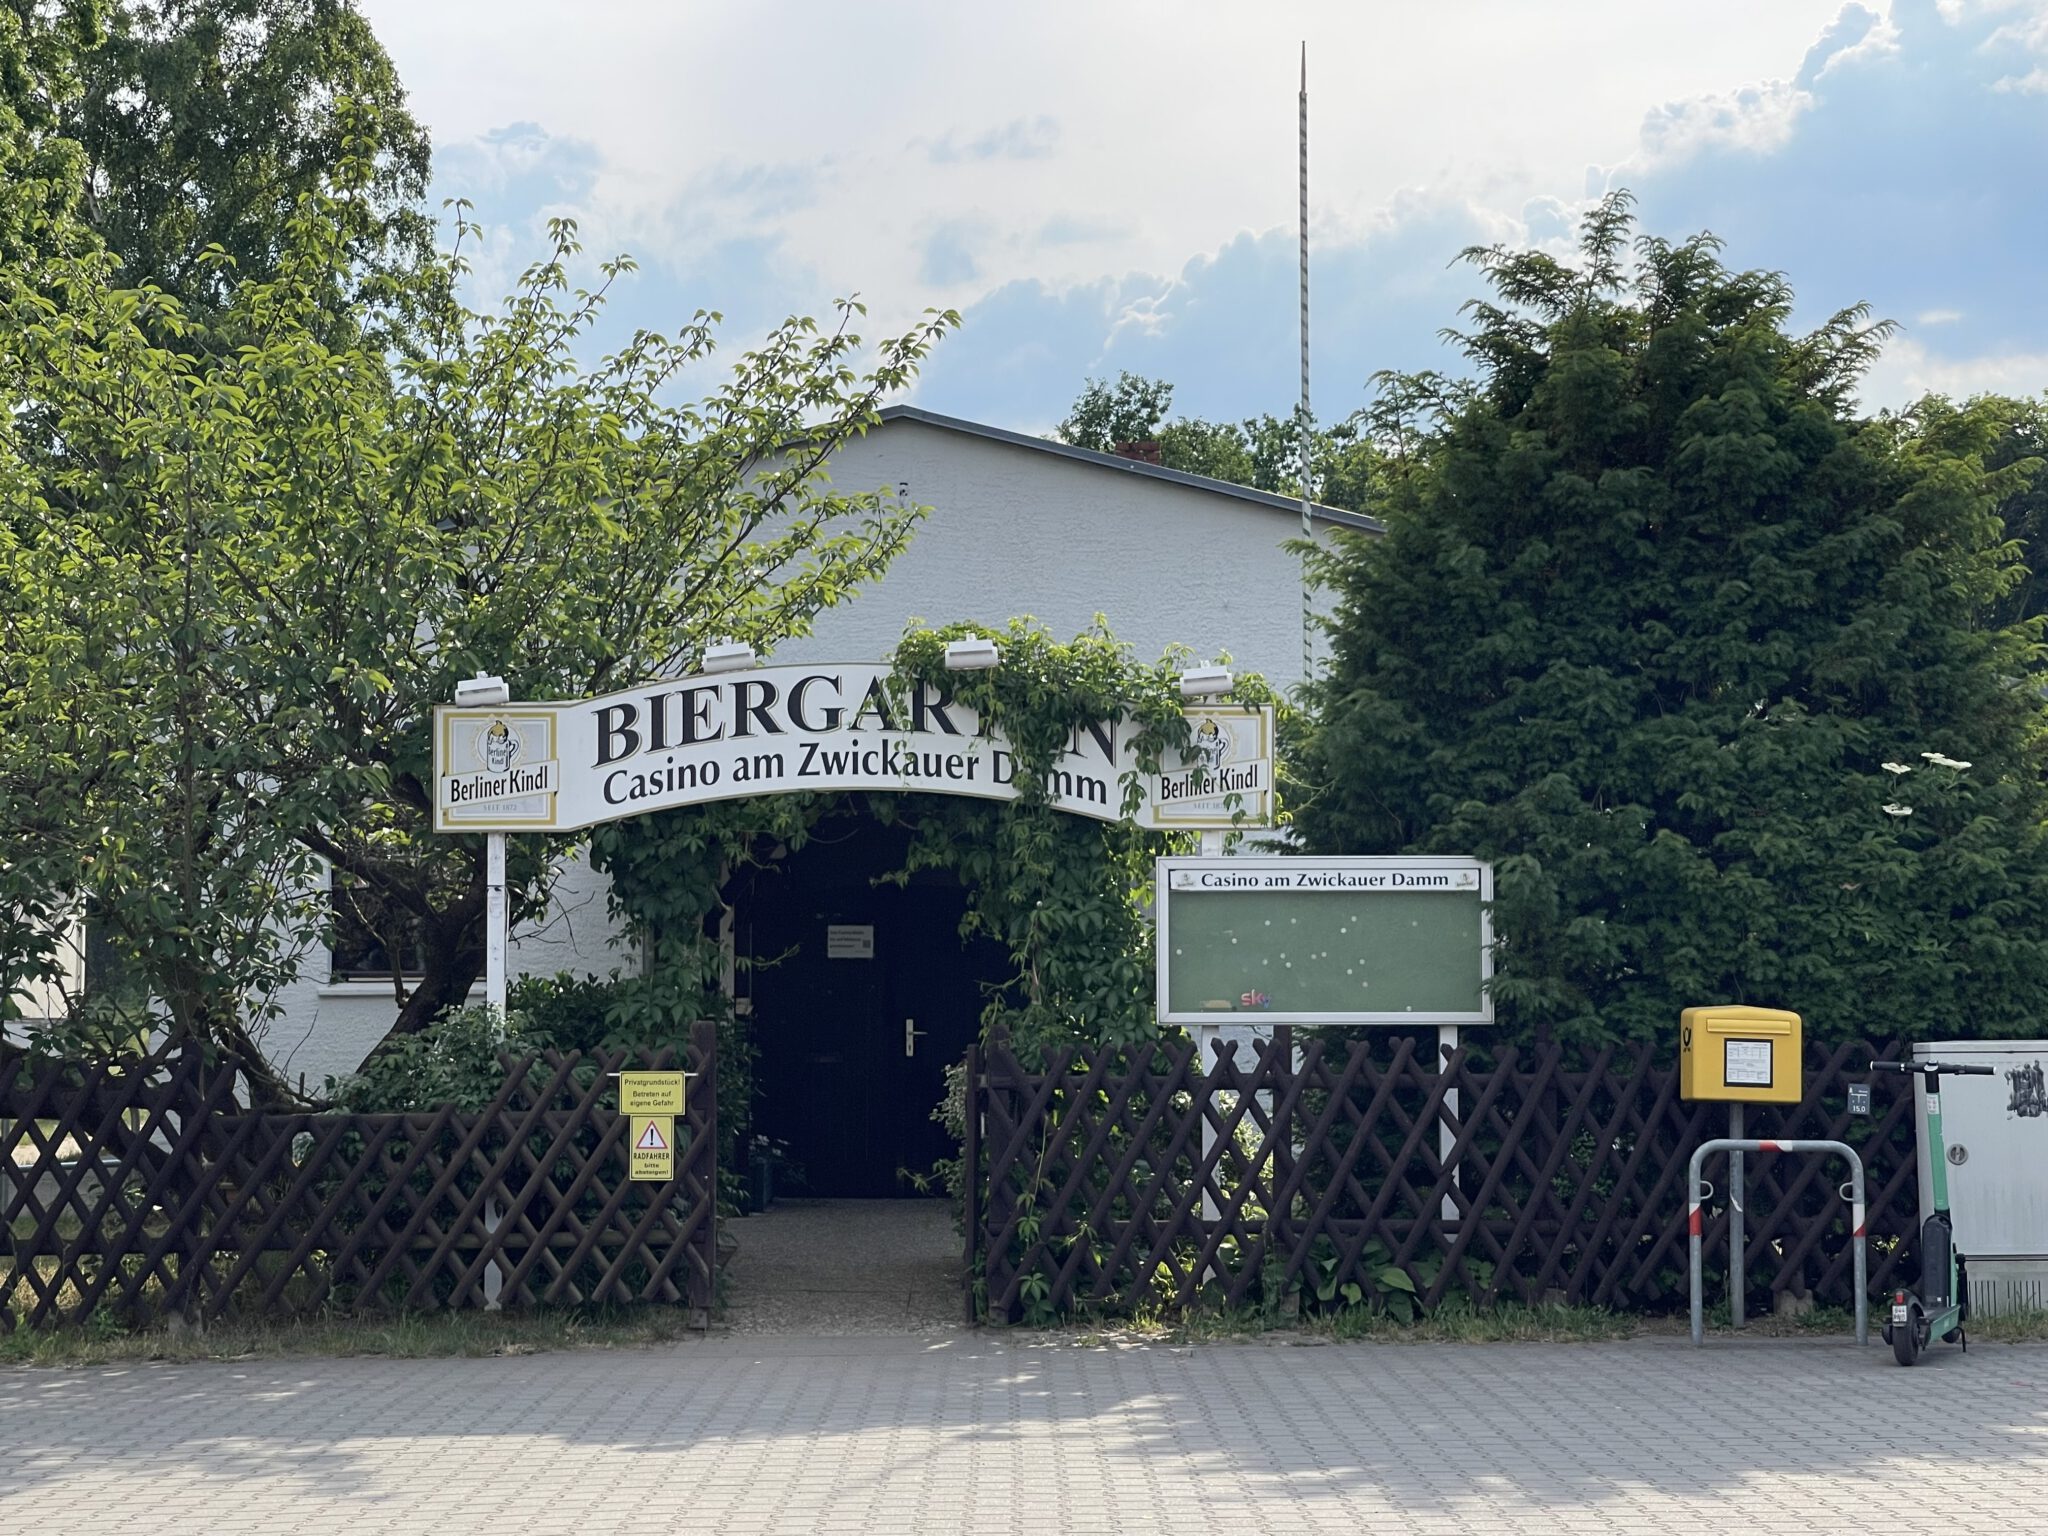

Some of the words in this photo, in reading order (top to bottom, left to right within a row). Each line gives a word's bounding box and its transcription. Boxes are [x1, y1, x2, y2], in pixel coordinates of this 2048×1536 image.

[603, 755, 720, 805] Casino
[733, 753, 784, 782] am
[797, 738, 980, 781] Zwickauer
[993, 750, 1107, 805] Dmm
[1219, 764, 1258, 793] Kindl
[451, 775, 507, 802] Berliner
[510, 765, 548, 794] Kindl
[1201, 872, 1259, 887] Casino
[1265, 876, 1290, 887] am
[1296, 871, 1386, 887] Zwickauer
[1393, 872, 1449, 887] Damm
[1241, 988, 1273, 1009] sky
[630, 1099, 651, 1107] eigene
[633, 1152, 670, 1160] RADFAHRER
